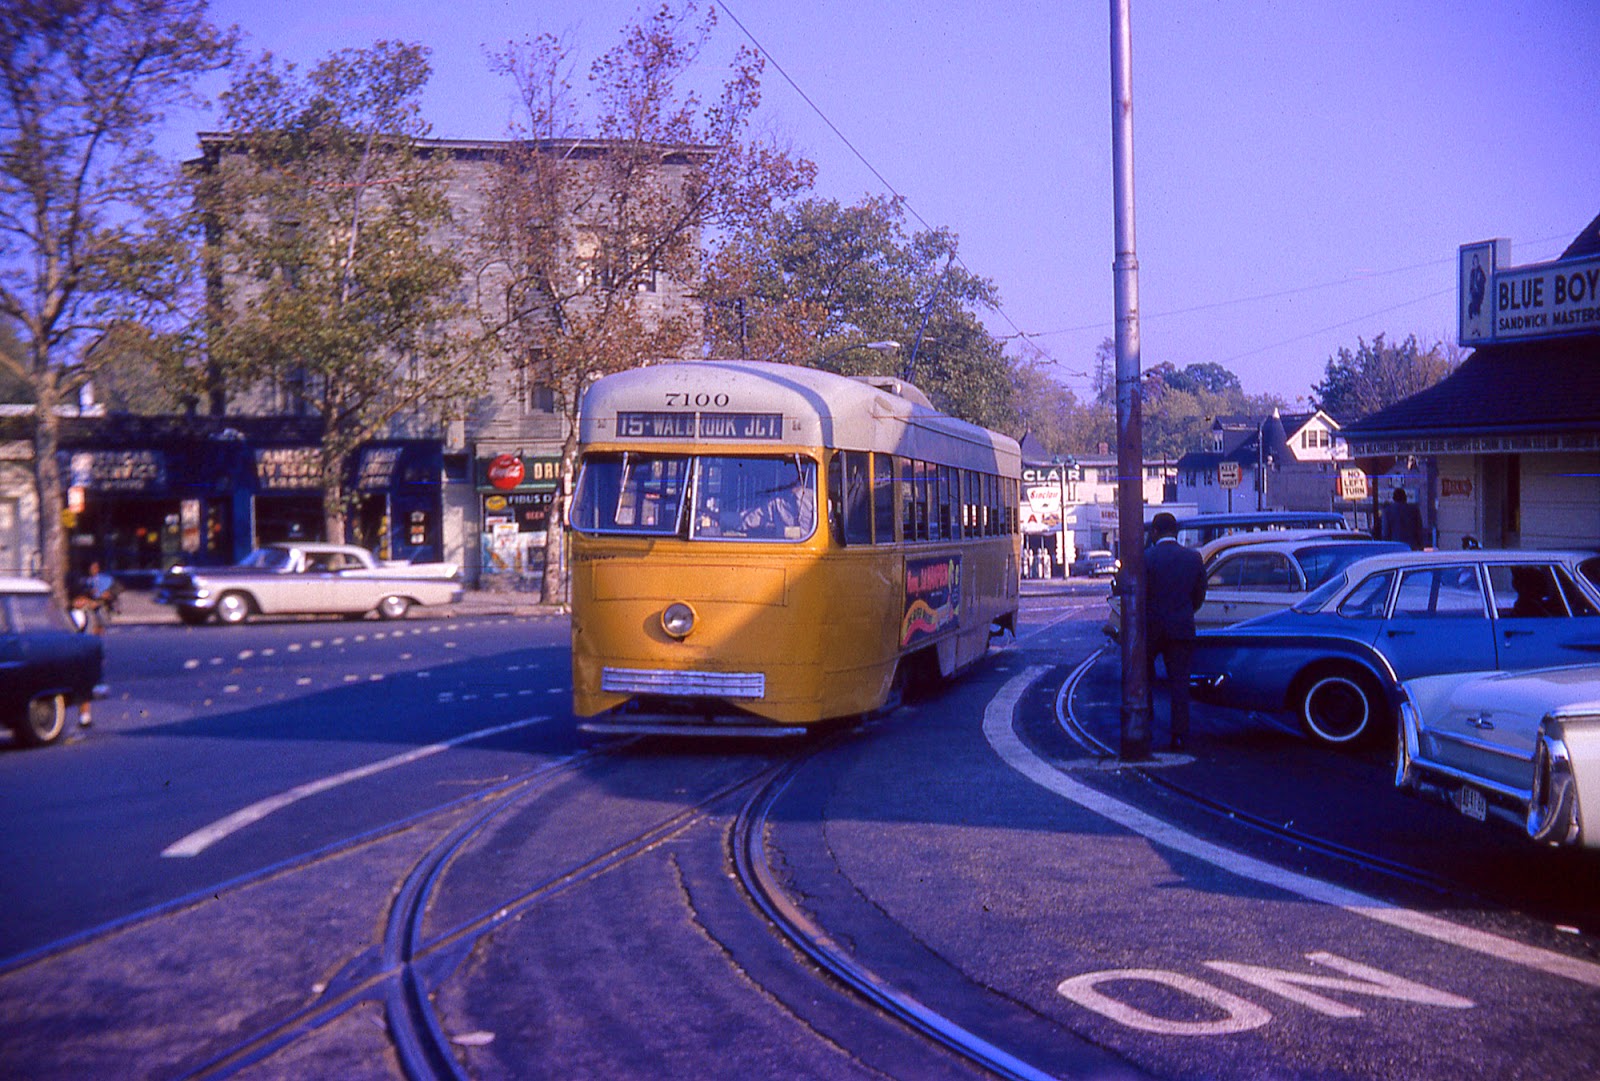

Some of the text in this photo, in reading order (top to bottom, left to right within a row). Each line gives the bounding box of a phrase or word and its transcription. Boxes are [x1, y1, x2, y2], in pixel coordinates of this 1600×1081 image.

[1498, 268, 1600, 311] BLUE BOY
[1498, 313, 1547, 331] SANDWICH
[665, 393, 730, 407] 7100
[653, 416, 737, 437] WALBROOK
[1344, 479, 1364, 487] LEFT
[1344, 487, 1365, 496] TURN
